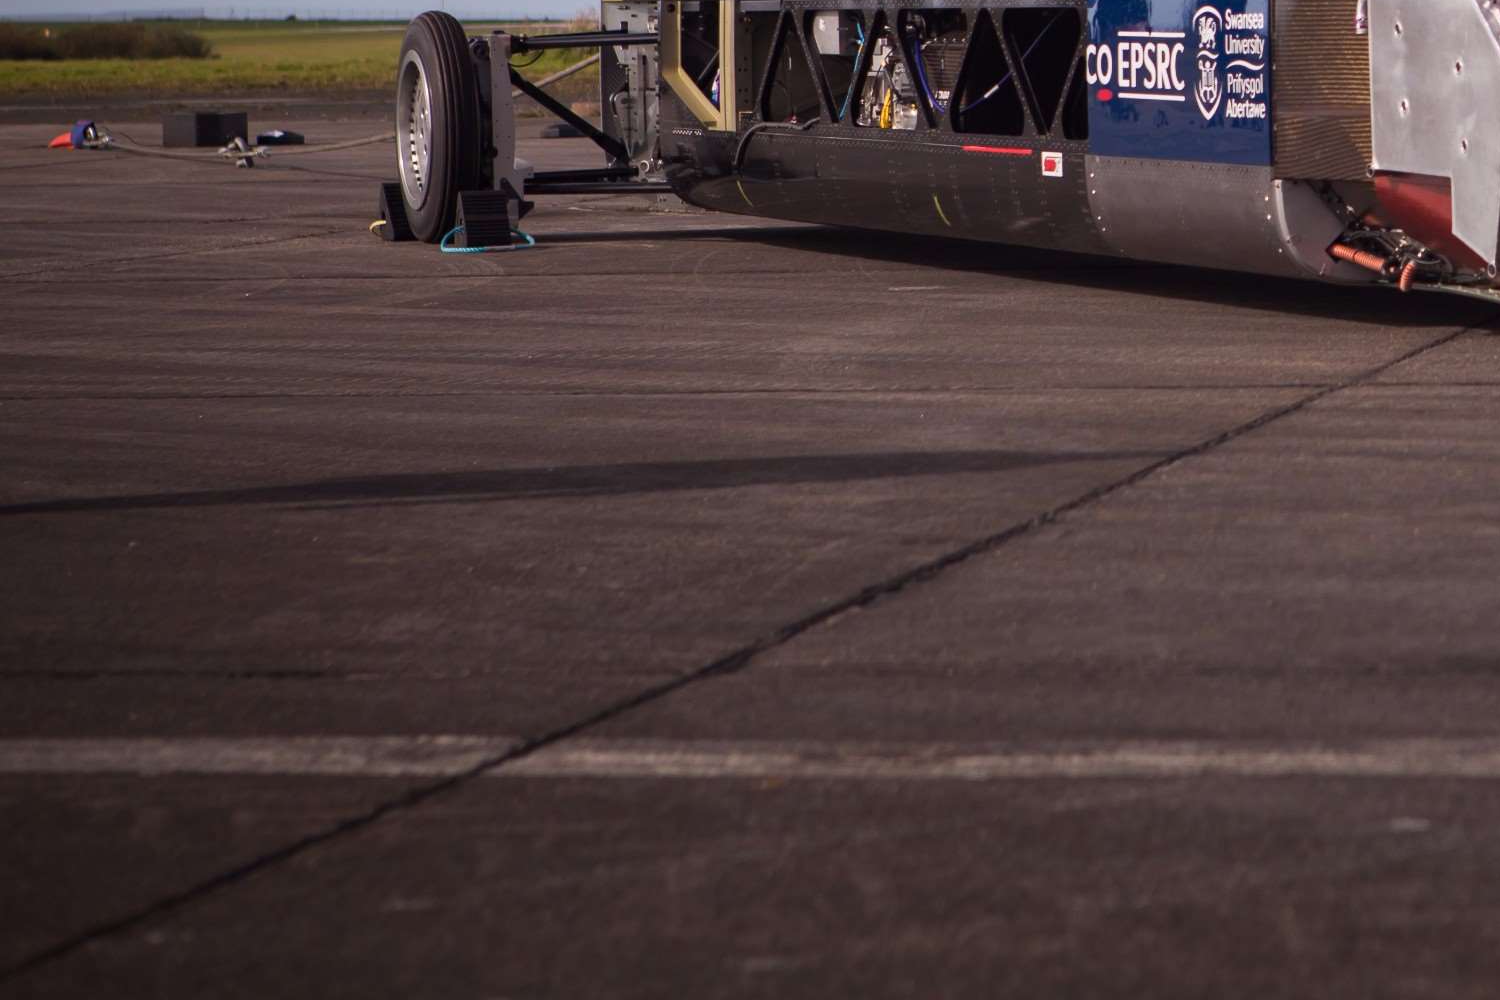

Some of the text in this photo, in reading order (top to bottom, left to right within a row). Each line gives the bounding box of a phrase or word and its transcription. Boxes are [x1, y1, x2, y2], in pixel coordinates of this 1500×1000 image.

[1225, 8, 1264, 30] Swansea
[1225, 33, 1264, 60] University
[1118, 42, 1186, 91] EPSRC
[1225, 100, 1266, 120] Abertawe
